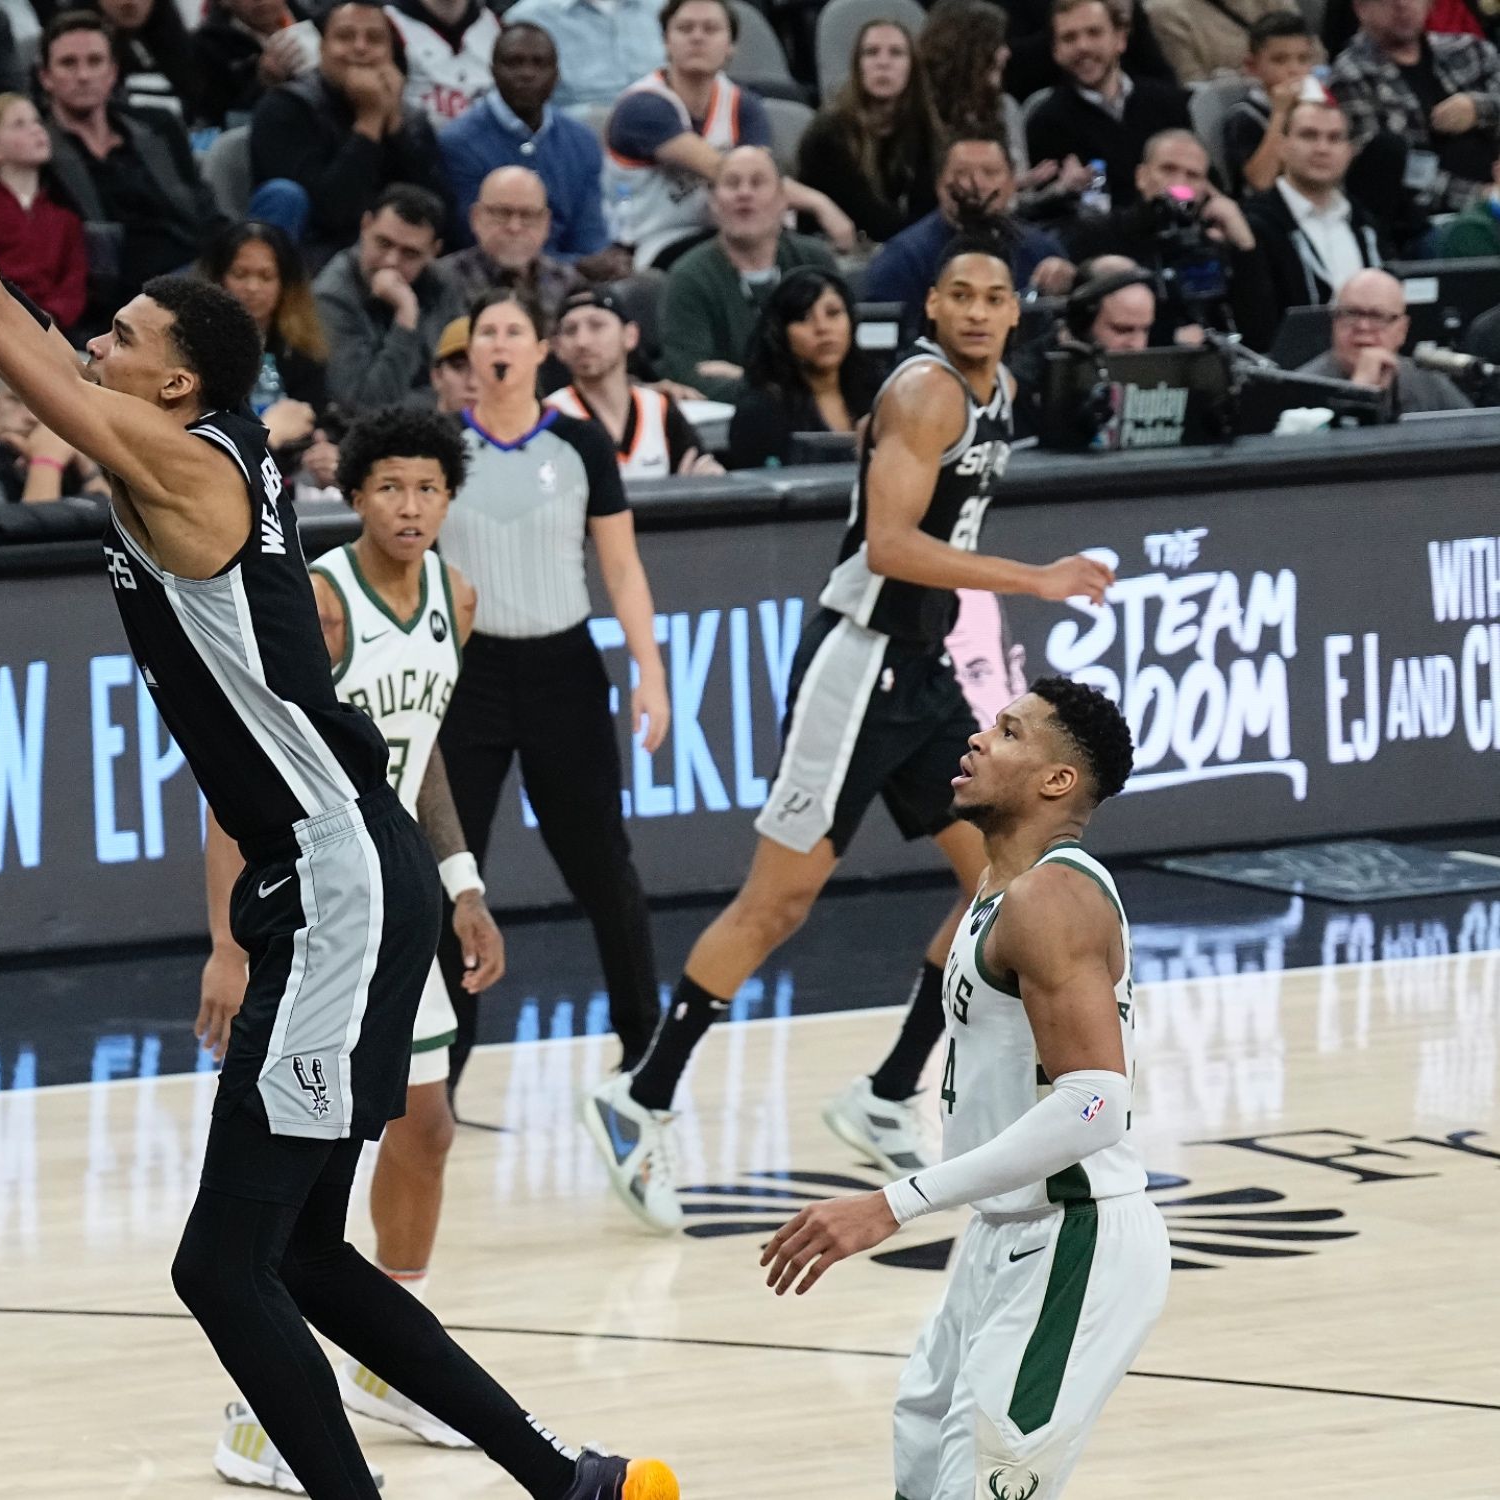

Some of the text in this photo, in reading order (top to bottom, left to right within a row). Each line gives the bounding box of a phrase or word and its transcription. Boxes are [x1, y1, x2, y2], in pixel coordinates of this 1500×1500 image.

[1144, 529, 1209, 569] THE
[1046, 547, 1298, 674] STEAM
[348, 668, 454, 724] BUCKS
[1324, 632, 1381, 764] EJ
[1387, 655, 1457, 742] AND
